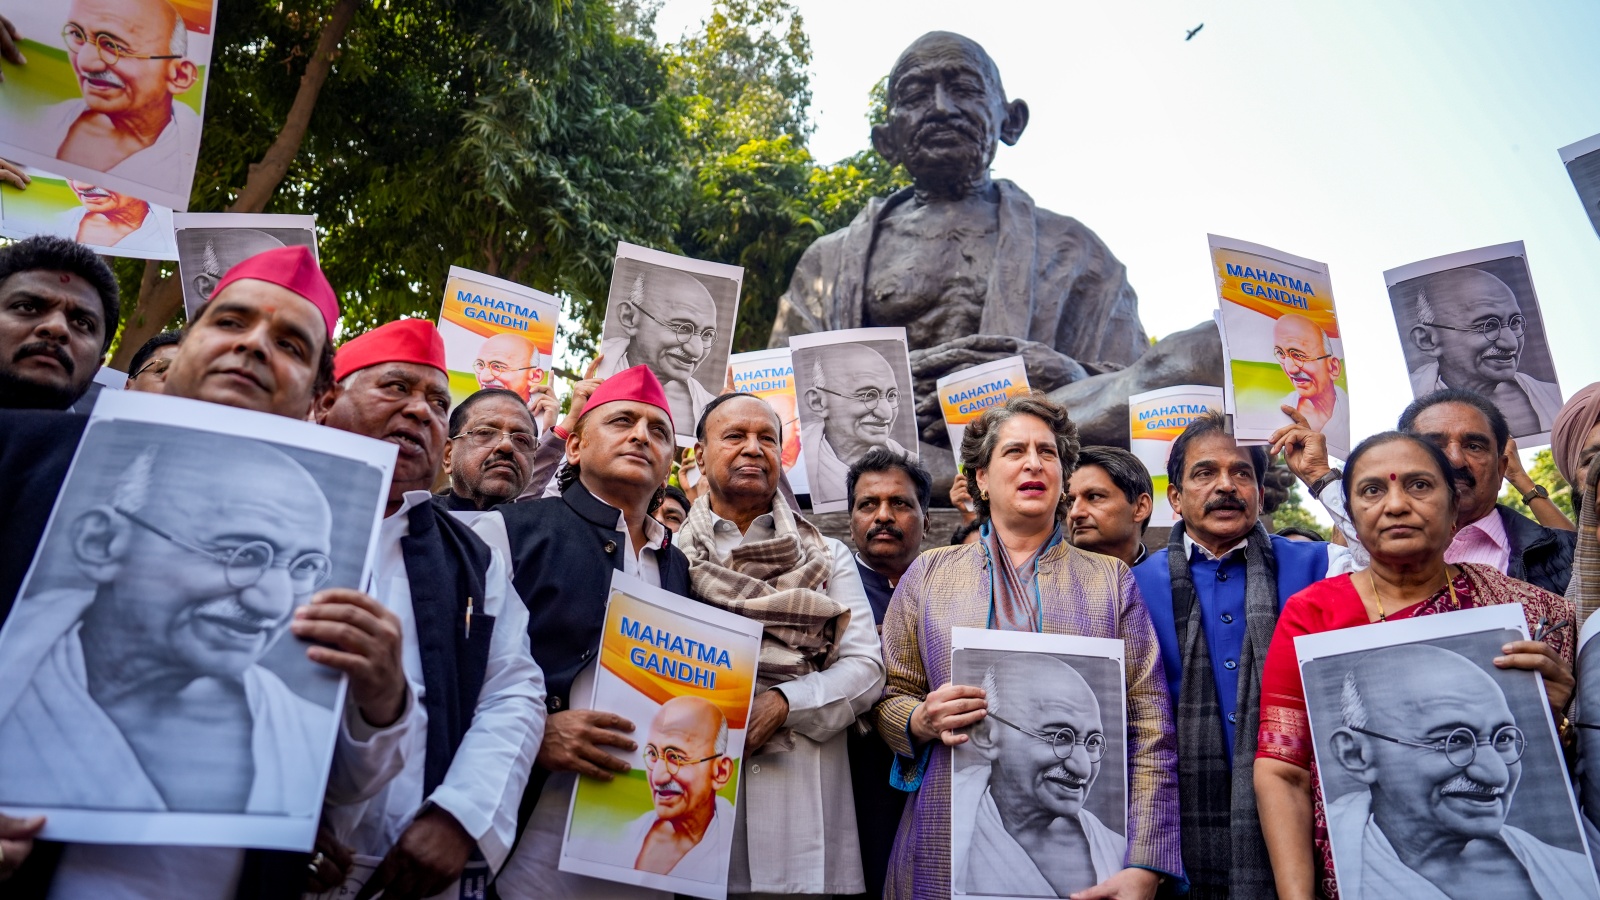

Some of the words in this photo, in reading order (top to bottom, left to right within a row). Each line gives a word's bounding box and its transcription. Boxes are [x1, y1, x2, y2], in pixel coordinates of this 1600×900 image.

[1226, 263, 1315, 297] MAHATMA
[457, 290, 540, 321] MAHATMA
[1240, 282, 1309, 310] GANDHI
[464, 307, 529, 331] GANDHI
[734, 367, 794, 382] AHATMA
[948, 379, 1012, 405] MAHATMA
[959, 392, 1008, 414] GANDHI
[1139, 404, 1208, 420] MAHATMA
[620, 616, 732, 670] MAHATMA
[630, 647, 716, 690] GANDHI
